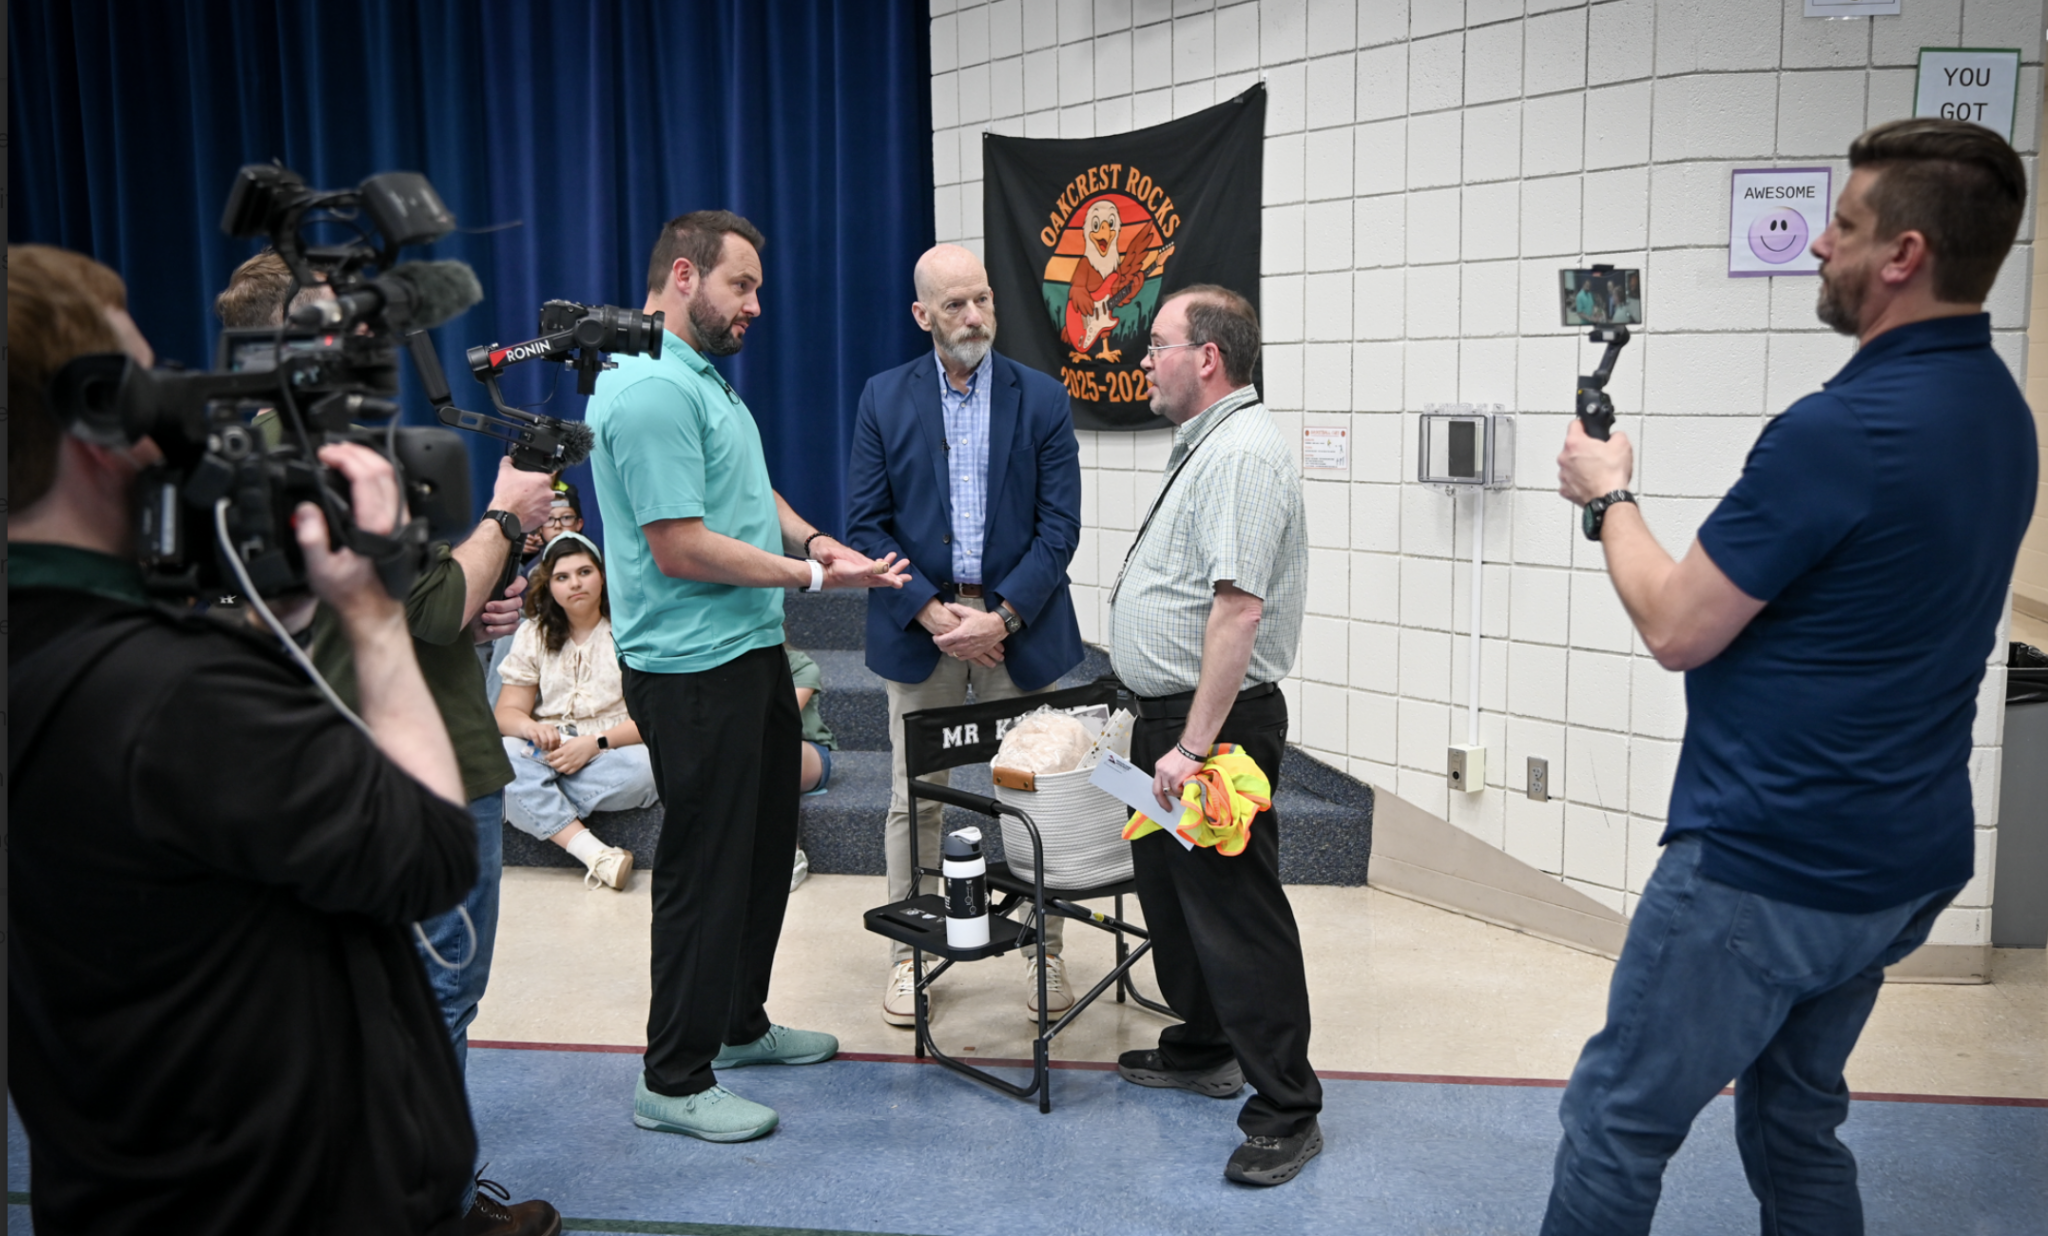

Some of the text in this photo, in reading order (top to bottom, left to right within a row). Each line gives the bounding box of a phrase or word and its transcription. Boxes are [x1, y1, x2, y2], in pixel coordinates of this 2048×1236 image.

[1944, 67, 1991, 87] YOU
[1940, 102, 1989, 121] GOT
[1744, 186, 1816, 199] AWESOME
[1041, 163, 1181, 247] OAKCREST ROCKS
[505, 339, 551, 362] RONIN
[1061, 366, 1155, 402] 2025-202
[943, 722, 980, 749] MR
